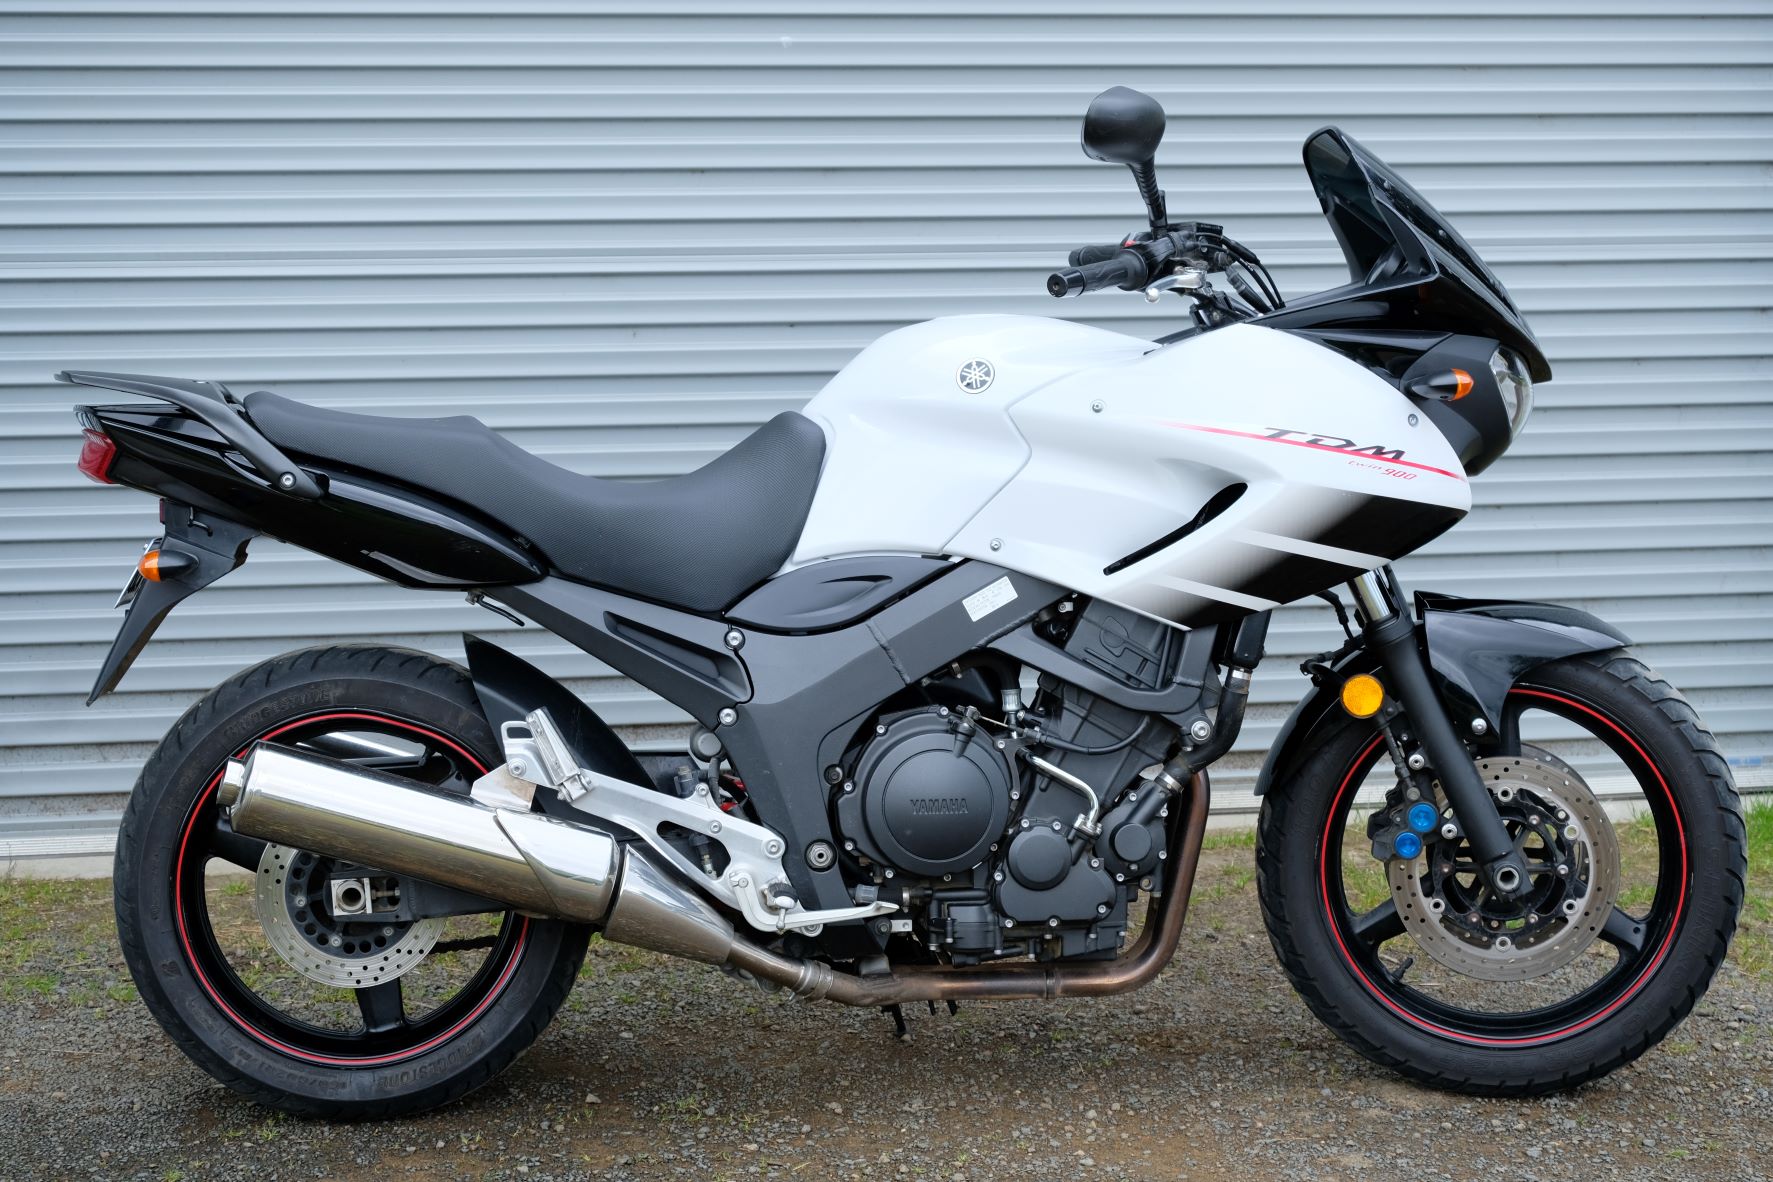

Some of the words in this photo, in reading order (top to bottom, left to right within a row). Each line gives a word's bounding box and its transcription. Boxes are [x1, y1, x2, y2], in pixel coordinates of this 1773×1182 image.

[1264, 427, 1405, 460] TDM
[1381, 468, 1417, 480] 900
[910, 798, 969, 815] YAMAHA
